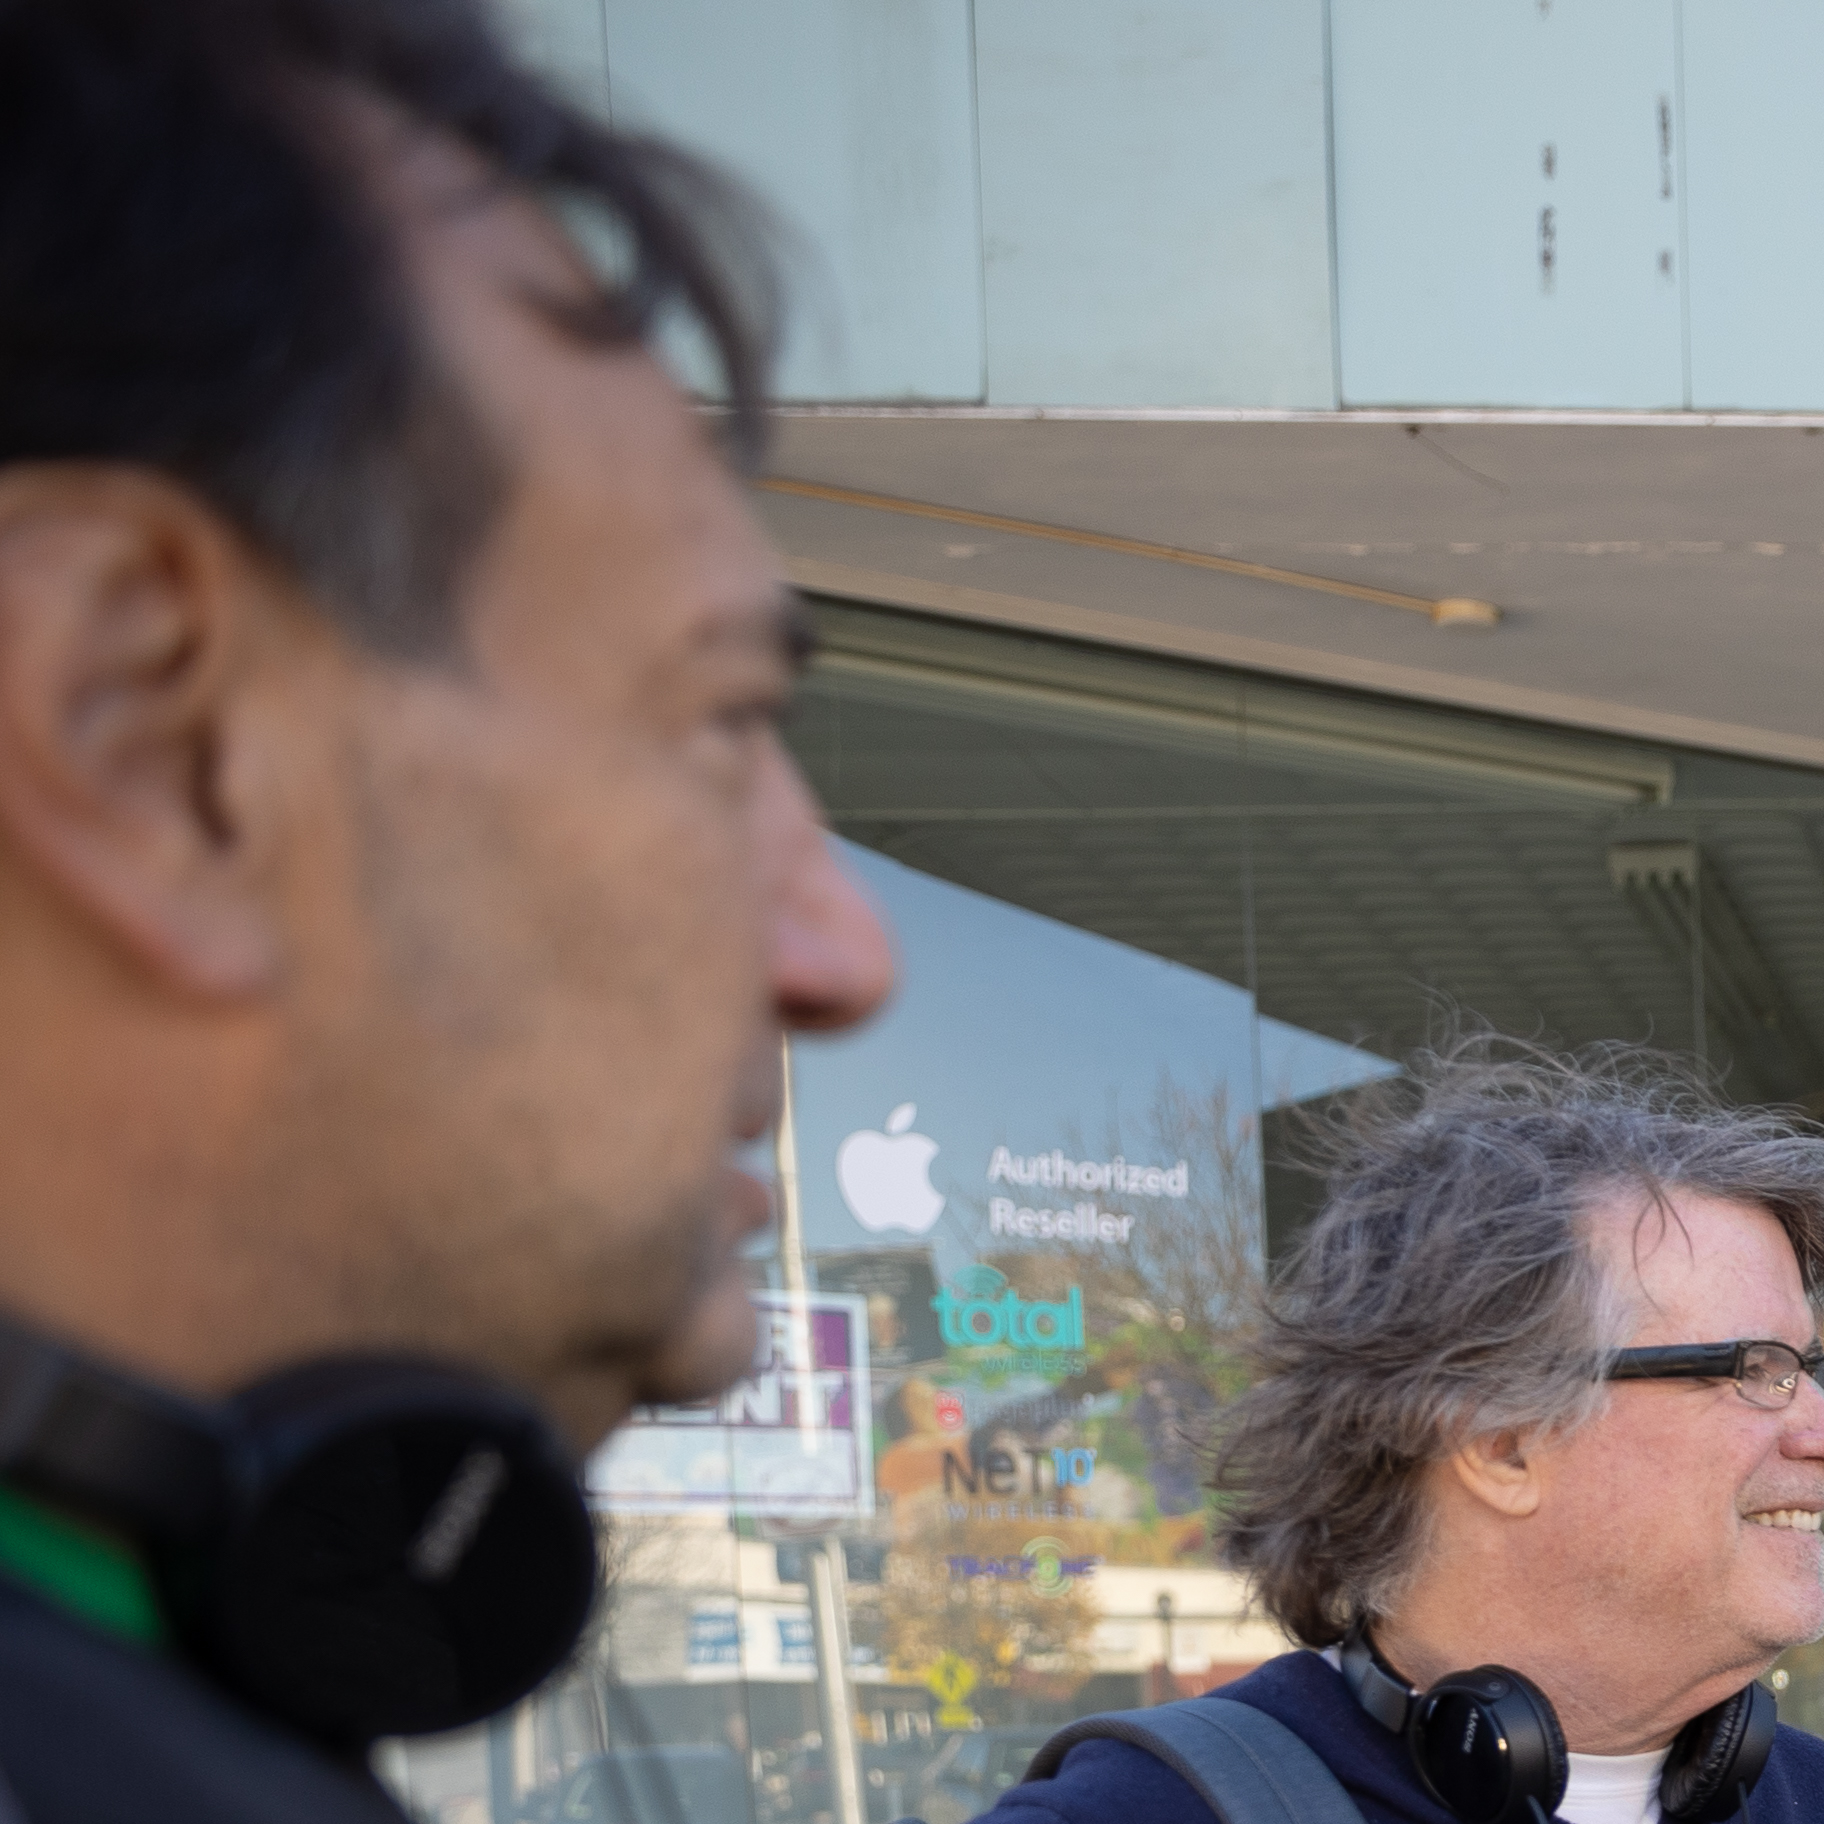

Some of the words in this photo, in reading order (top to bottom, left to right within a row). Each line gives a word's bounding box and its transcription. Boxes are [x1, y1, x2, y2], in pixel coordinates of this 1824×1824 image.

[987, 1145, 1189, 1198] Authorized
[989, 1196, 1135, 1244] Reseller
[931, 1285, 1085, 1350] total
